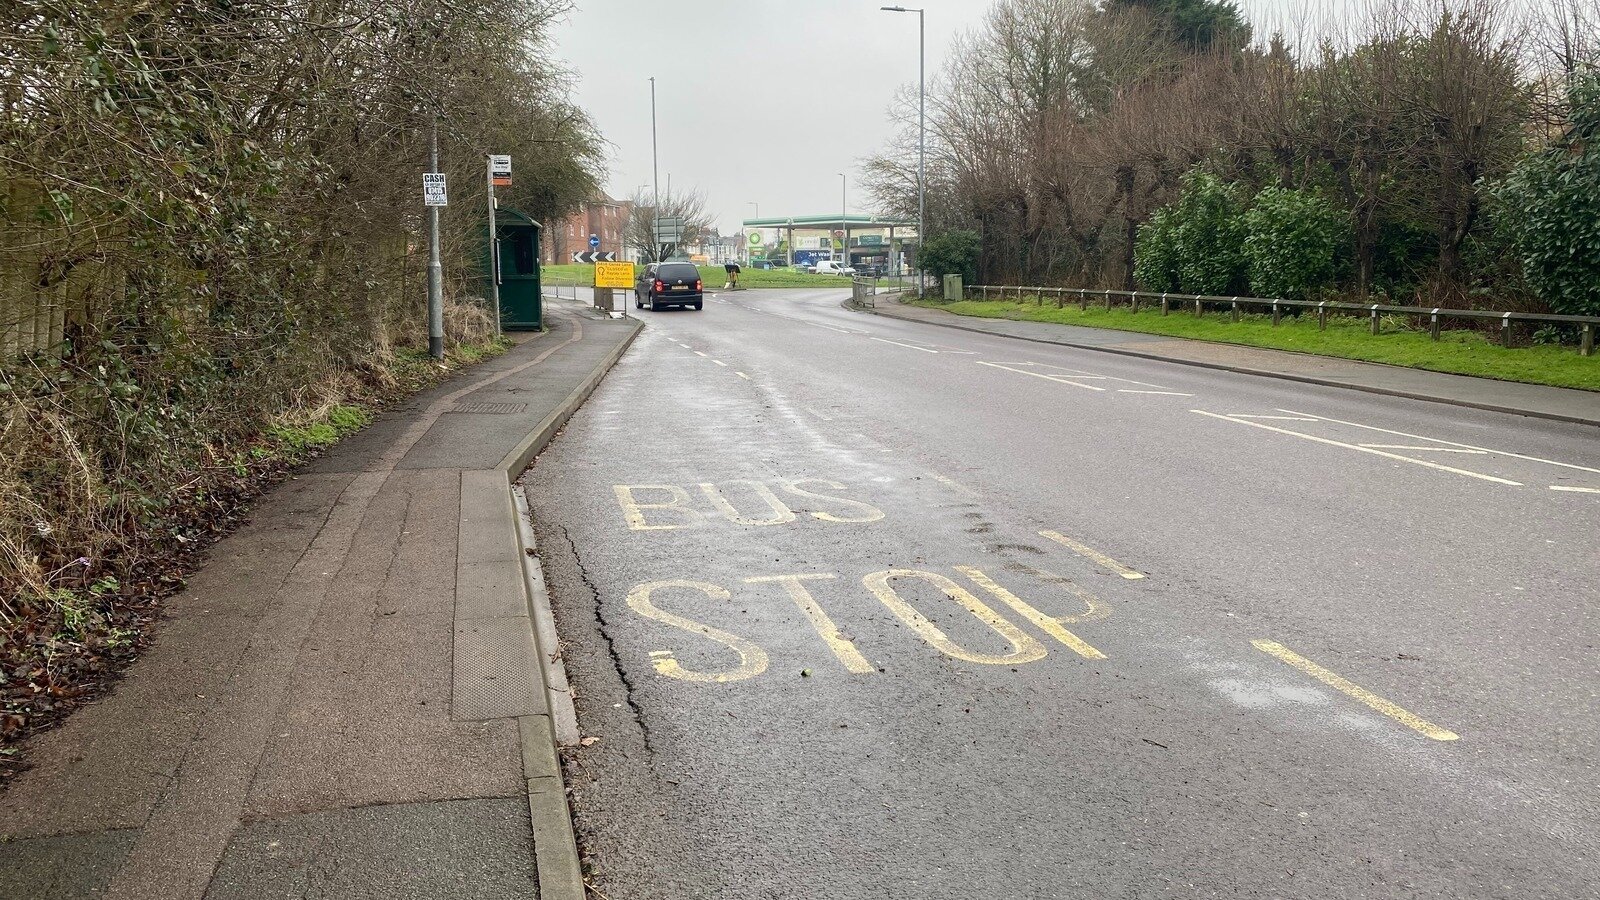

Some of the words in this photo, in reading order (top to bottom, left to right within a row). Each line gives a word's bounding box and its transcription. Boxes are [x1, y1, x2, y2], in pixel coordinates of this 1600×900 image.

[424, 174, 445, 182] CASH
[613, 478, 885, 531] BUS
[625, 565, 1113, 683] STOP
